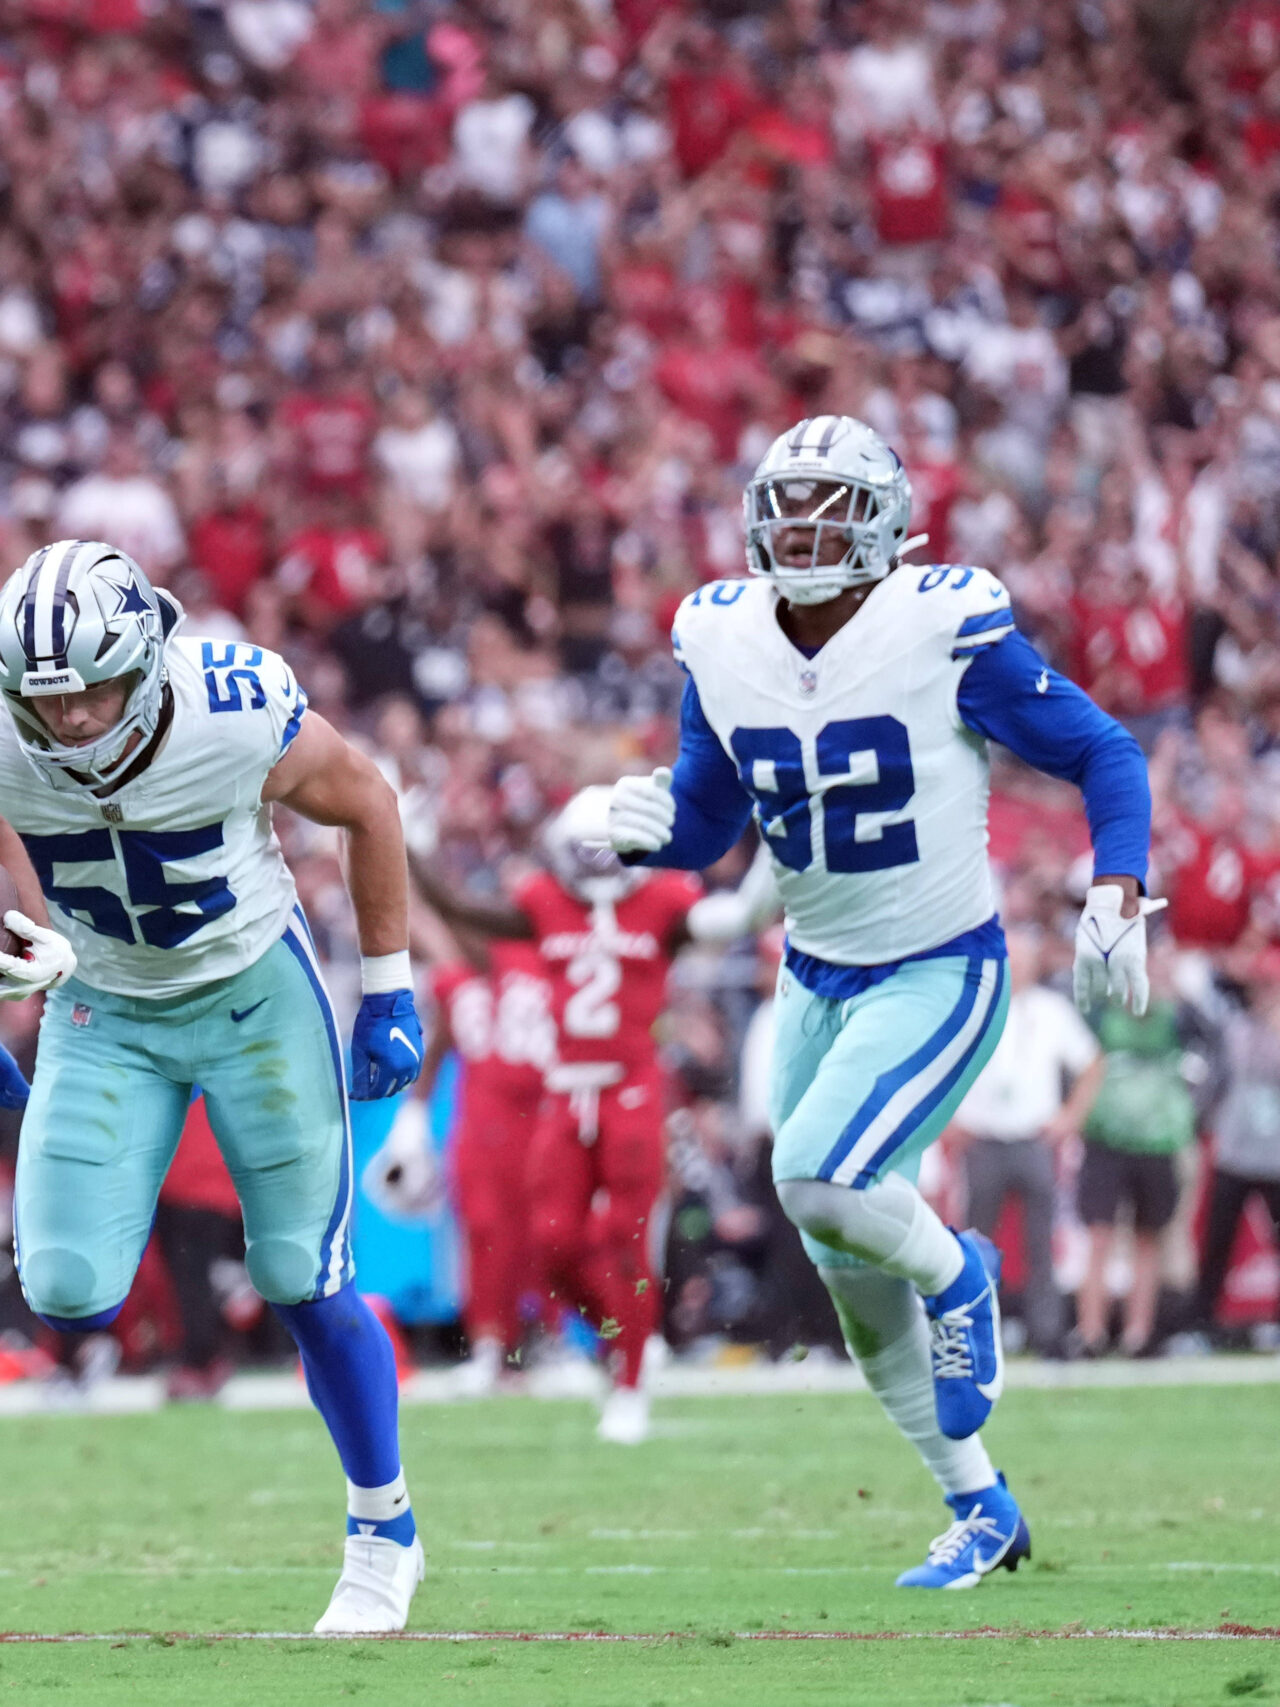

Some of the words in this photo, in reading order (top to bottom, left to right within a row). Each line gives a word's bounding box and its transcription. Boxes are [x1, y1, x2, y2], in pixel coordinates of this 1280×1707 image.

[28, 674, 70, 686] COWBOYS
[729, 714, 920, 874] 92
[17, 820, 238, 950] 55
[565, 952, 622, 1039] 2
